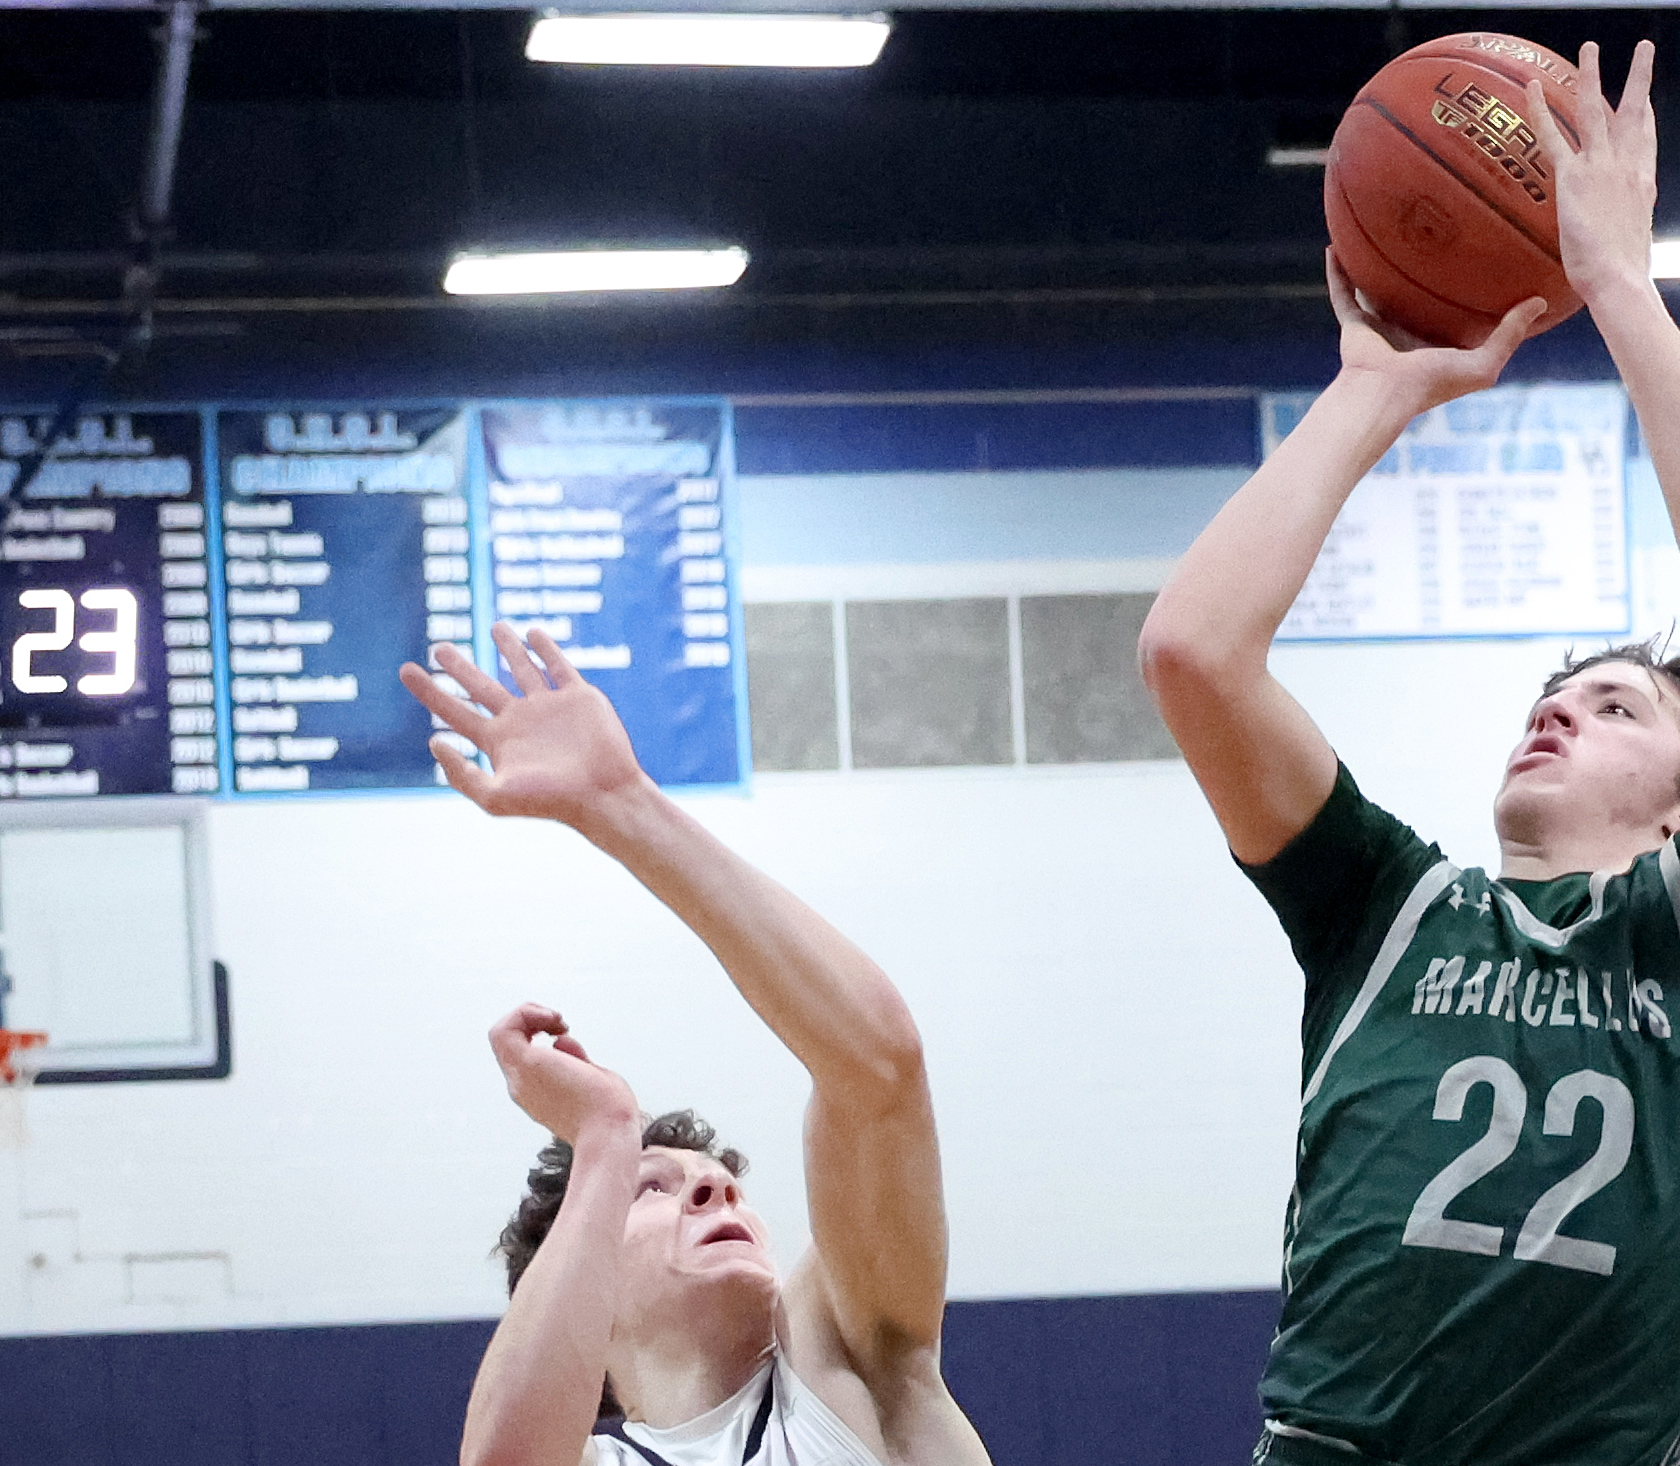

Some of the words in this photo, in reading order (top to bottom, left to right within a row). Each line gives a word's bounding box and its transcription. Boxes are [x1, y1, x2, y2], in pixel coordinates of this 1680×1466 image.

[1460, 121, 1547, 205] 1000
[12, 588, 138, 695] 23
[1401, 1054, 1635, 1276] 22
